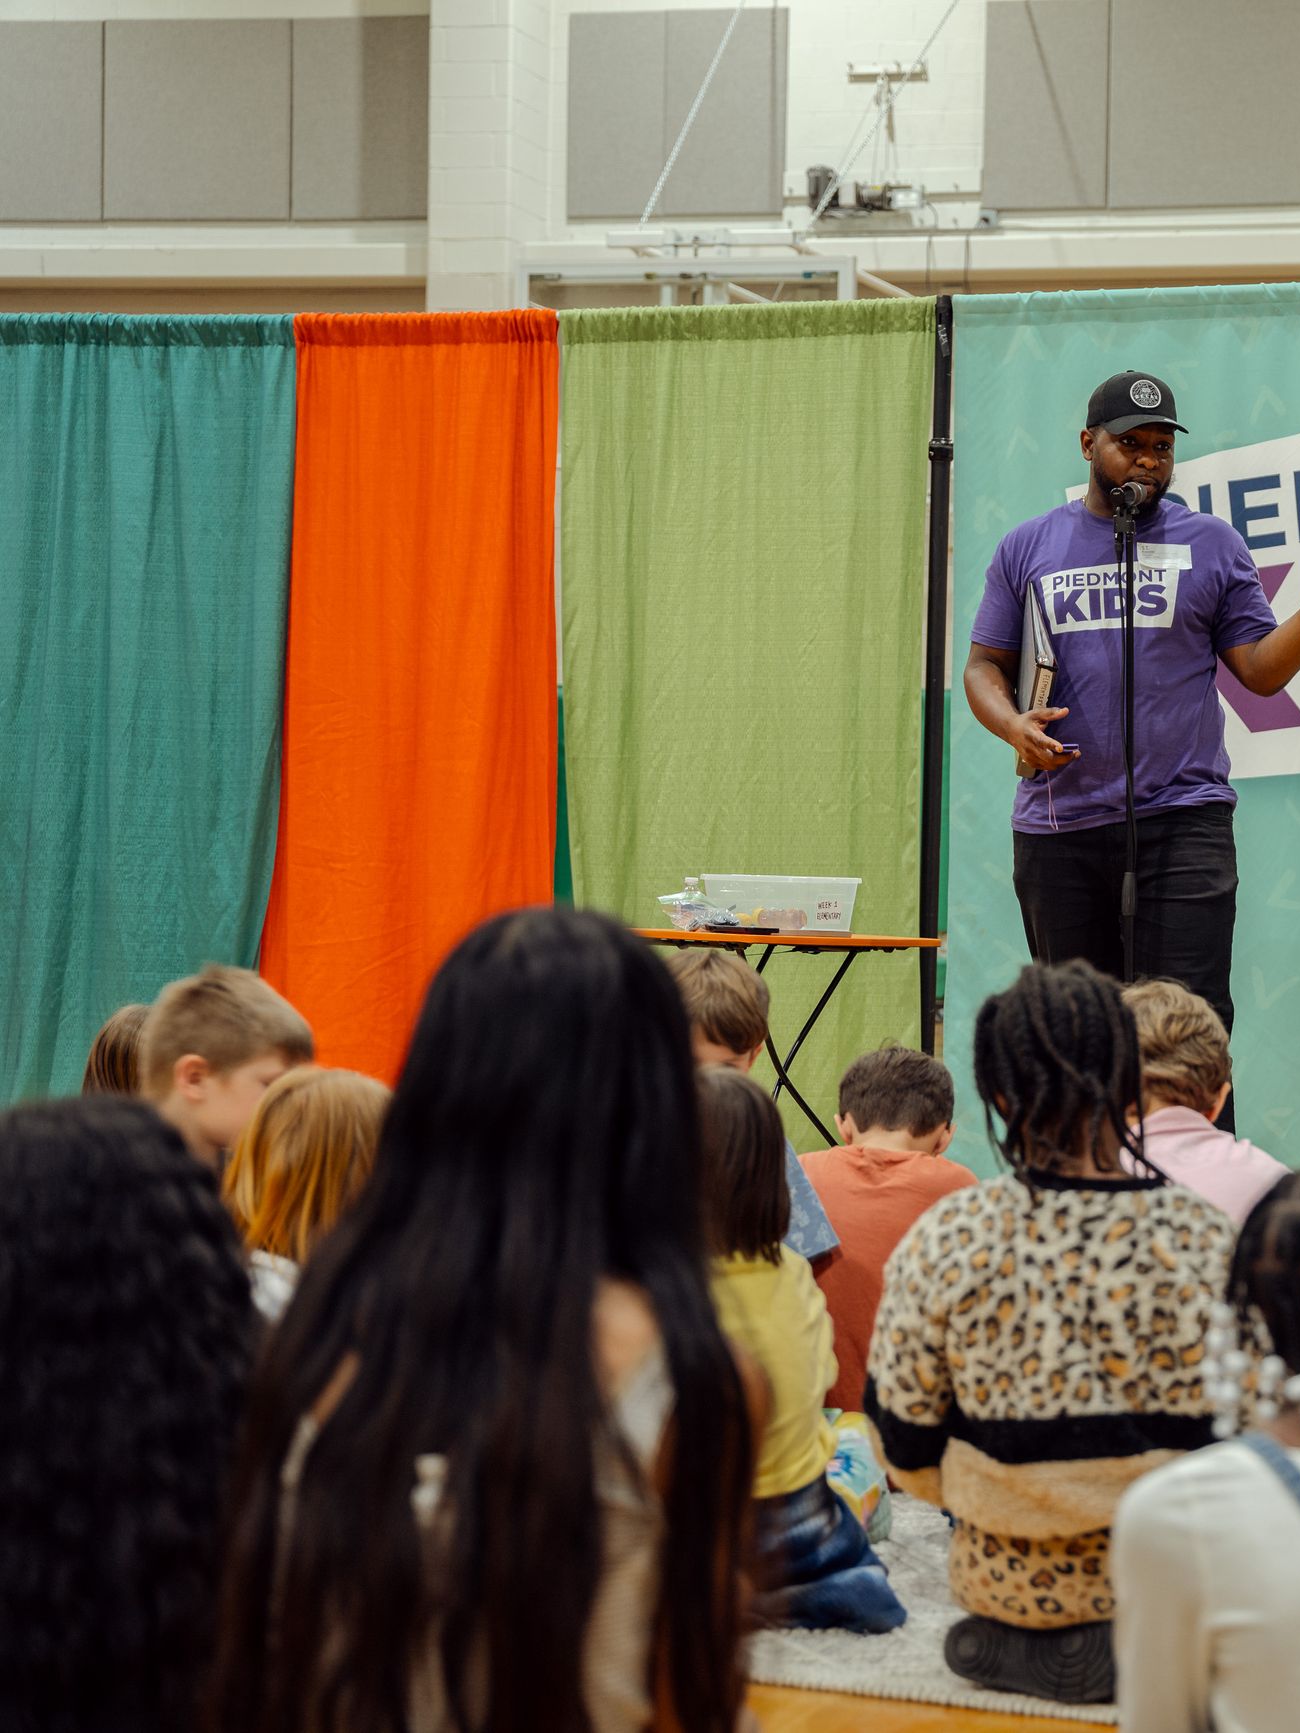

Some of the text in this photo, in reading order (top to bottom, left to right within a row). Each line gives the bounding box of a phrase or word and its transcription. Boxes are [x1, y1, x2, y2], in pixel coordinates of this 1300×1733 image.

[1052, 569, 1167, 591] PIEDMONT
[1053, 583, 1168, 626] KIDS
[817, 901, 832, 909] WEEK
